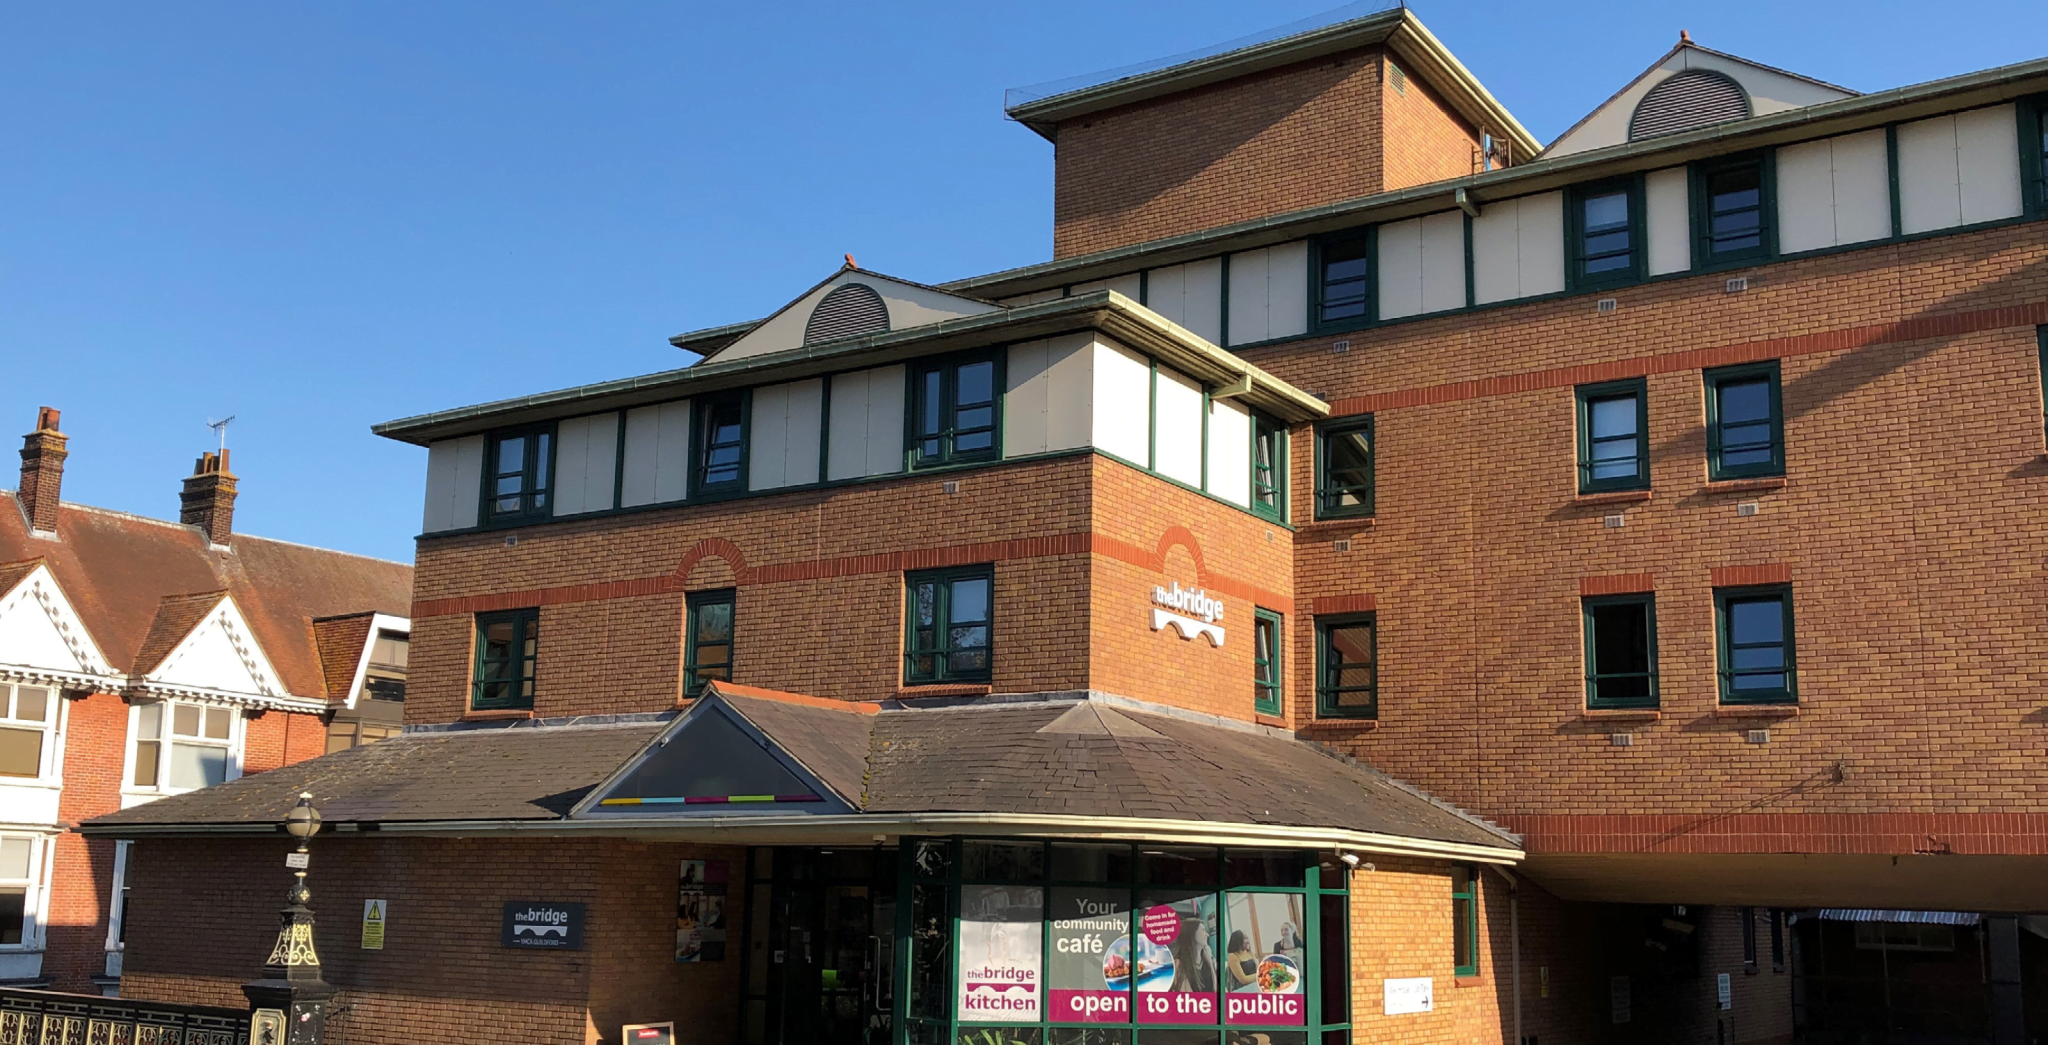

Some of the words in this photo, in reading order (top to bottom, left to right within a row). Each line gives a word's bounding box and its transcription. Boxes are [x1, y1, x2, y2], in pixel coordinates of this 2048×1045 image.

[1076, 898, 1117, 915] Your
[1054, 918, 1129, 934] community
[1145, 919, 1177, 928] homemade
[1057, 934, 1103, 954] café
[1156, 934, 1171, 942] drink
[965, 994, 1036, 1010] kitchen
[1070, 995, 1127, 1016] open
[1146, 993, 1169, 1013] to
[1175, 993, 1212, 1014] the
[1228, 994, 1298, 1019] public
